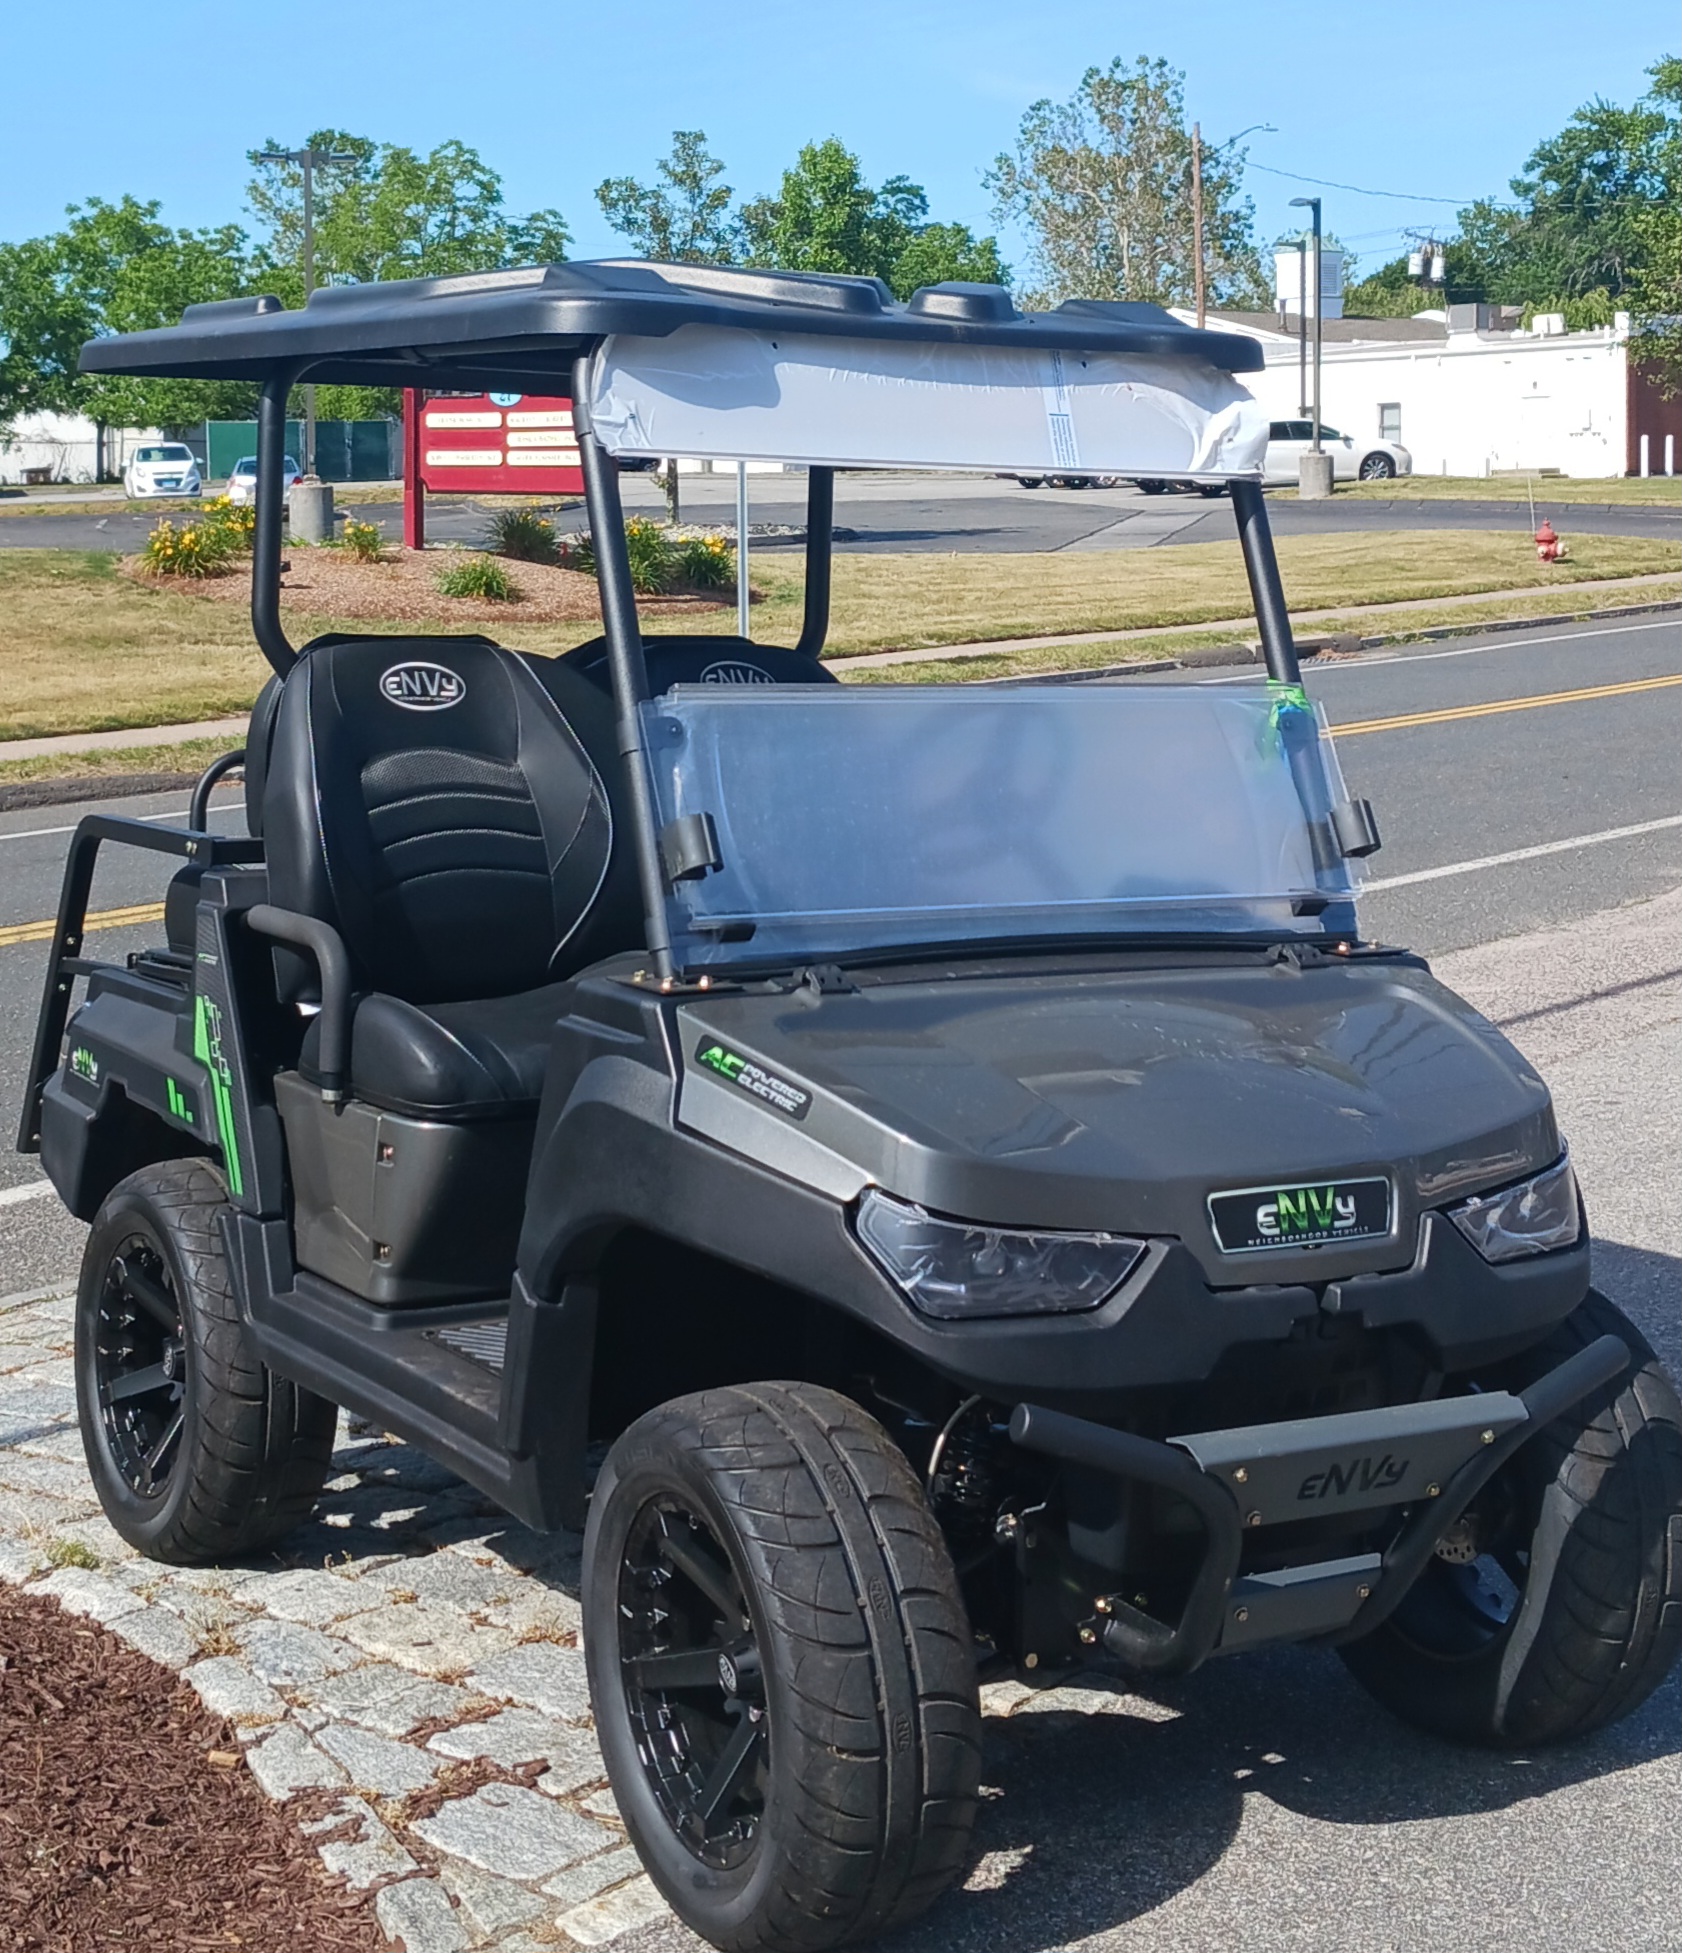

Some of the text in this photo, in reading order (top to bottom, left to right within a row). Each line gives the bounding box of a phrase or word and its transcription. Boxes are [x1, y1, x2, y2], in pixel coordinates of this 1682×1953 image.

[700, 1046, 745, 1078] AC
[737, 1073, 798, 1112] ELECTRIC
[743, 1063, 807, 1104] POWERED
